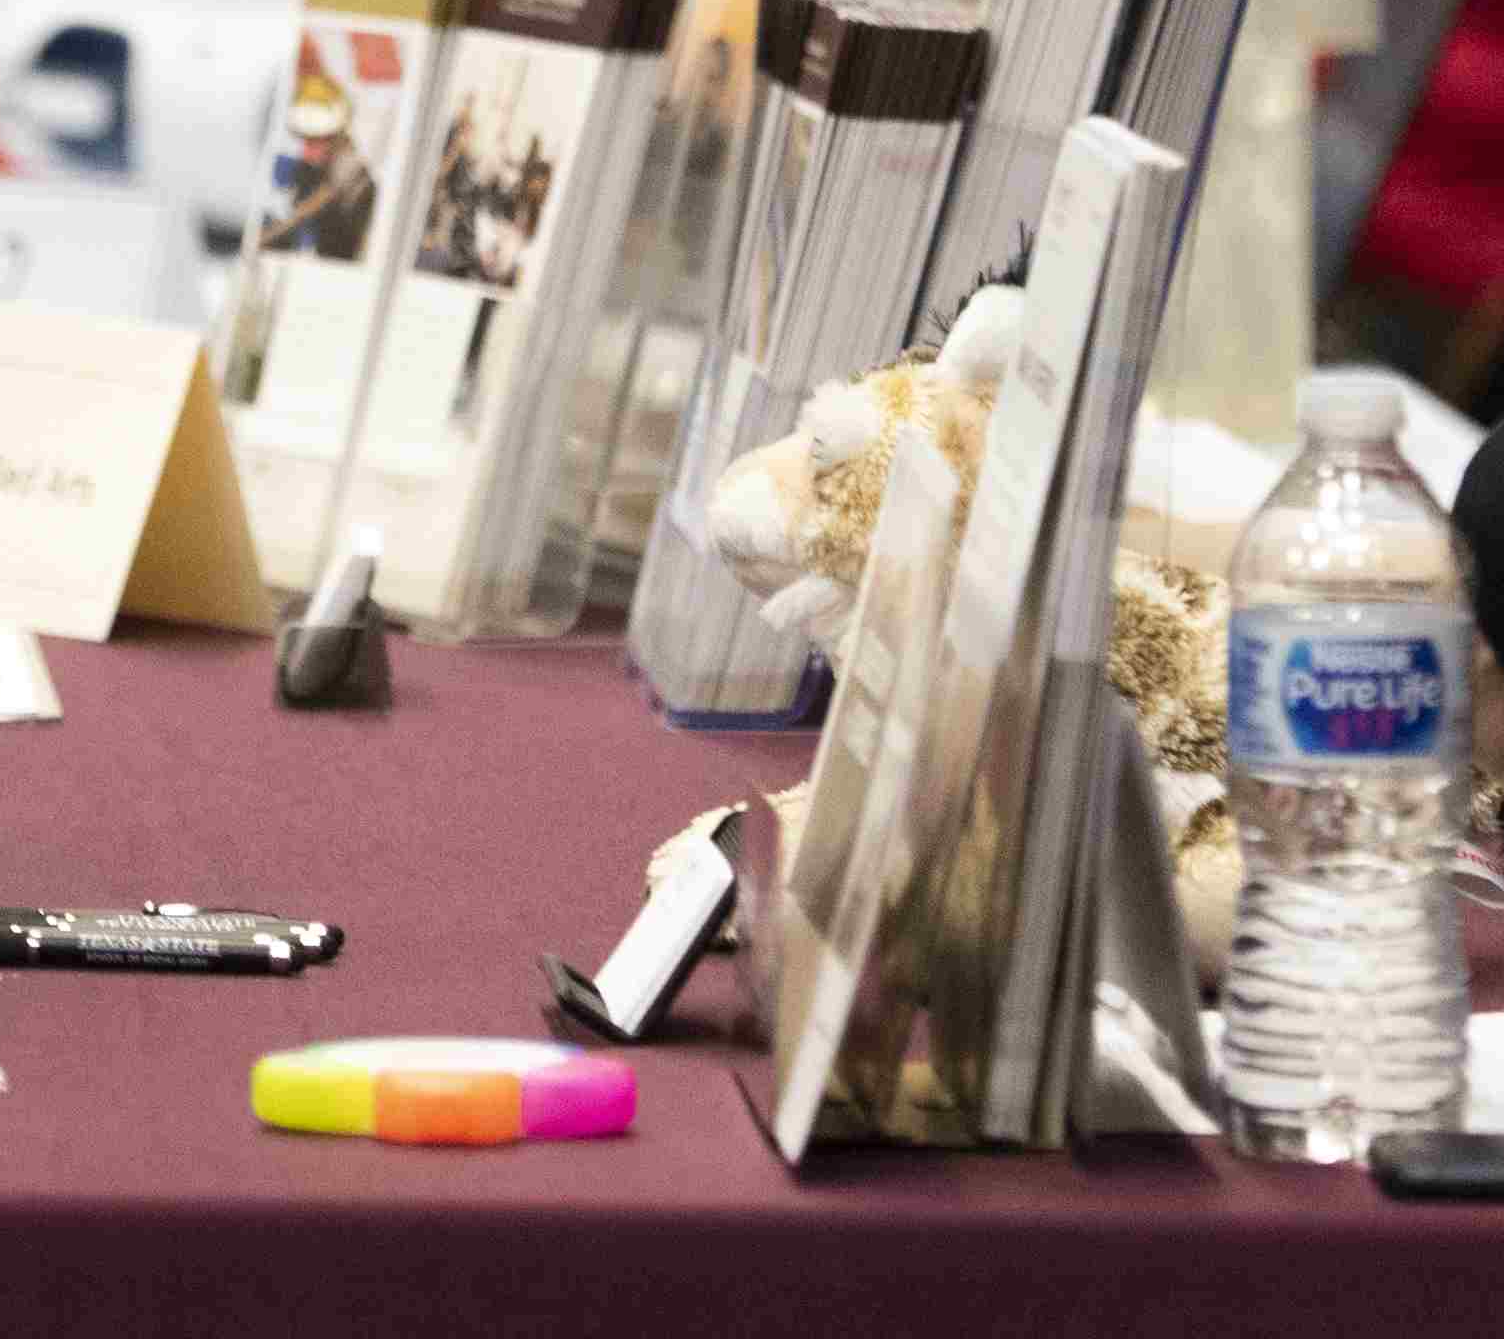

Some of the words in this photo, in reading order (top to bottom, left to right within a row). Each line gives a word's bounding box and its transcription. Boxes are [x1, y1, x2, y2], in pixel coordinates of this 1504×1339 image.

[43, 464, 98, 505] Arts
[1285, 671, 1380, 711] Pure
[1382, 671, 1442, 725] Life
[77, 932, 143, 950] TEXAS
[158, 937, 222, 956] STATE
